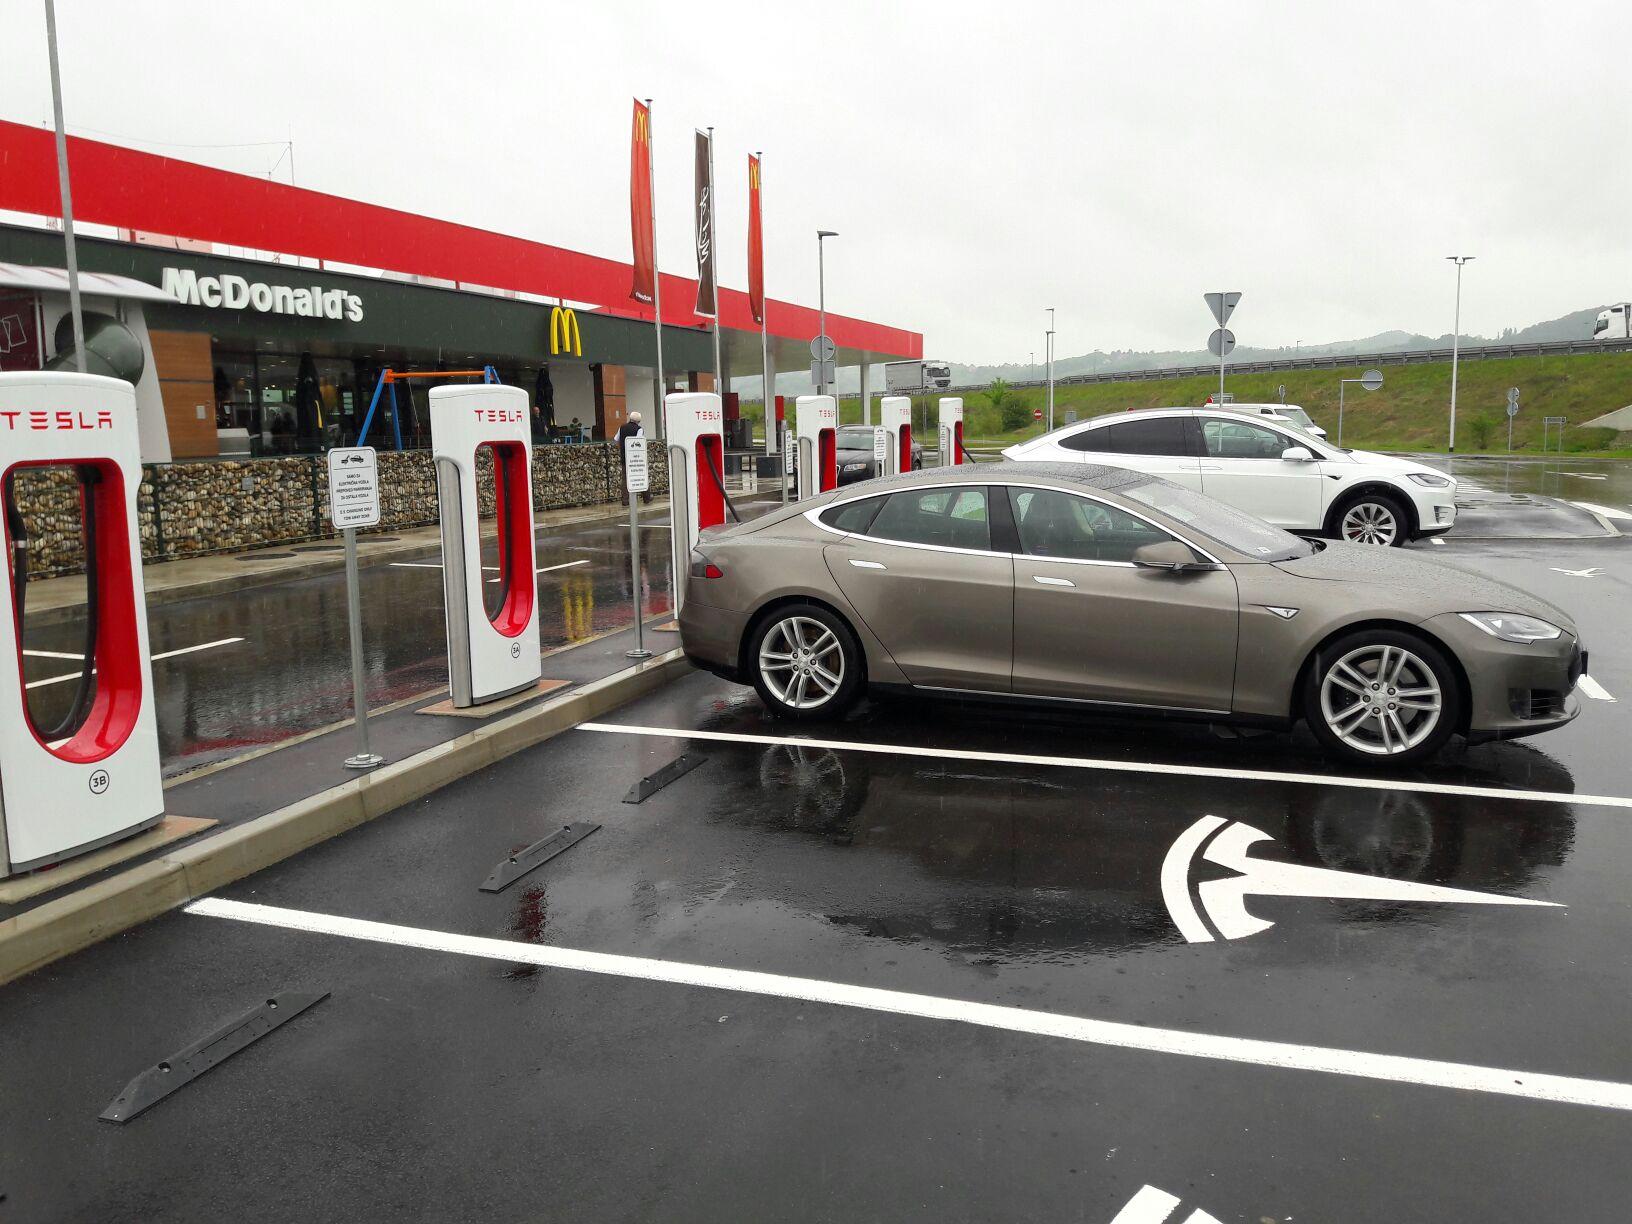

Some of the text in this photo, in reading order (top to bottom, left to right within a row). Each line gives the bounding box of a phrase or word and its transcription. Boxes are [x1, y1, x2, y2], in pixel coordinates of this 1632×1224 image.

[161, 267, 364, 322] McDonald's
[0, 411, 113, 430] TESLA
[474, 410, 523, 422] TESLA
[695, 411, 720, 420] TESLA
[92, 775, 107, 788] 3B
